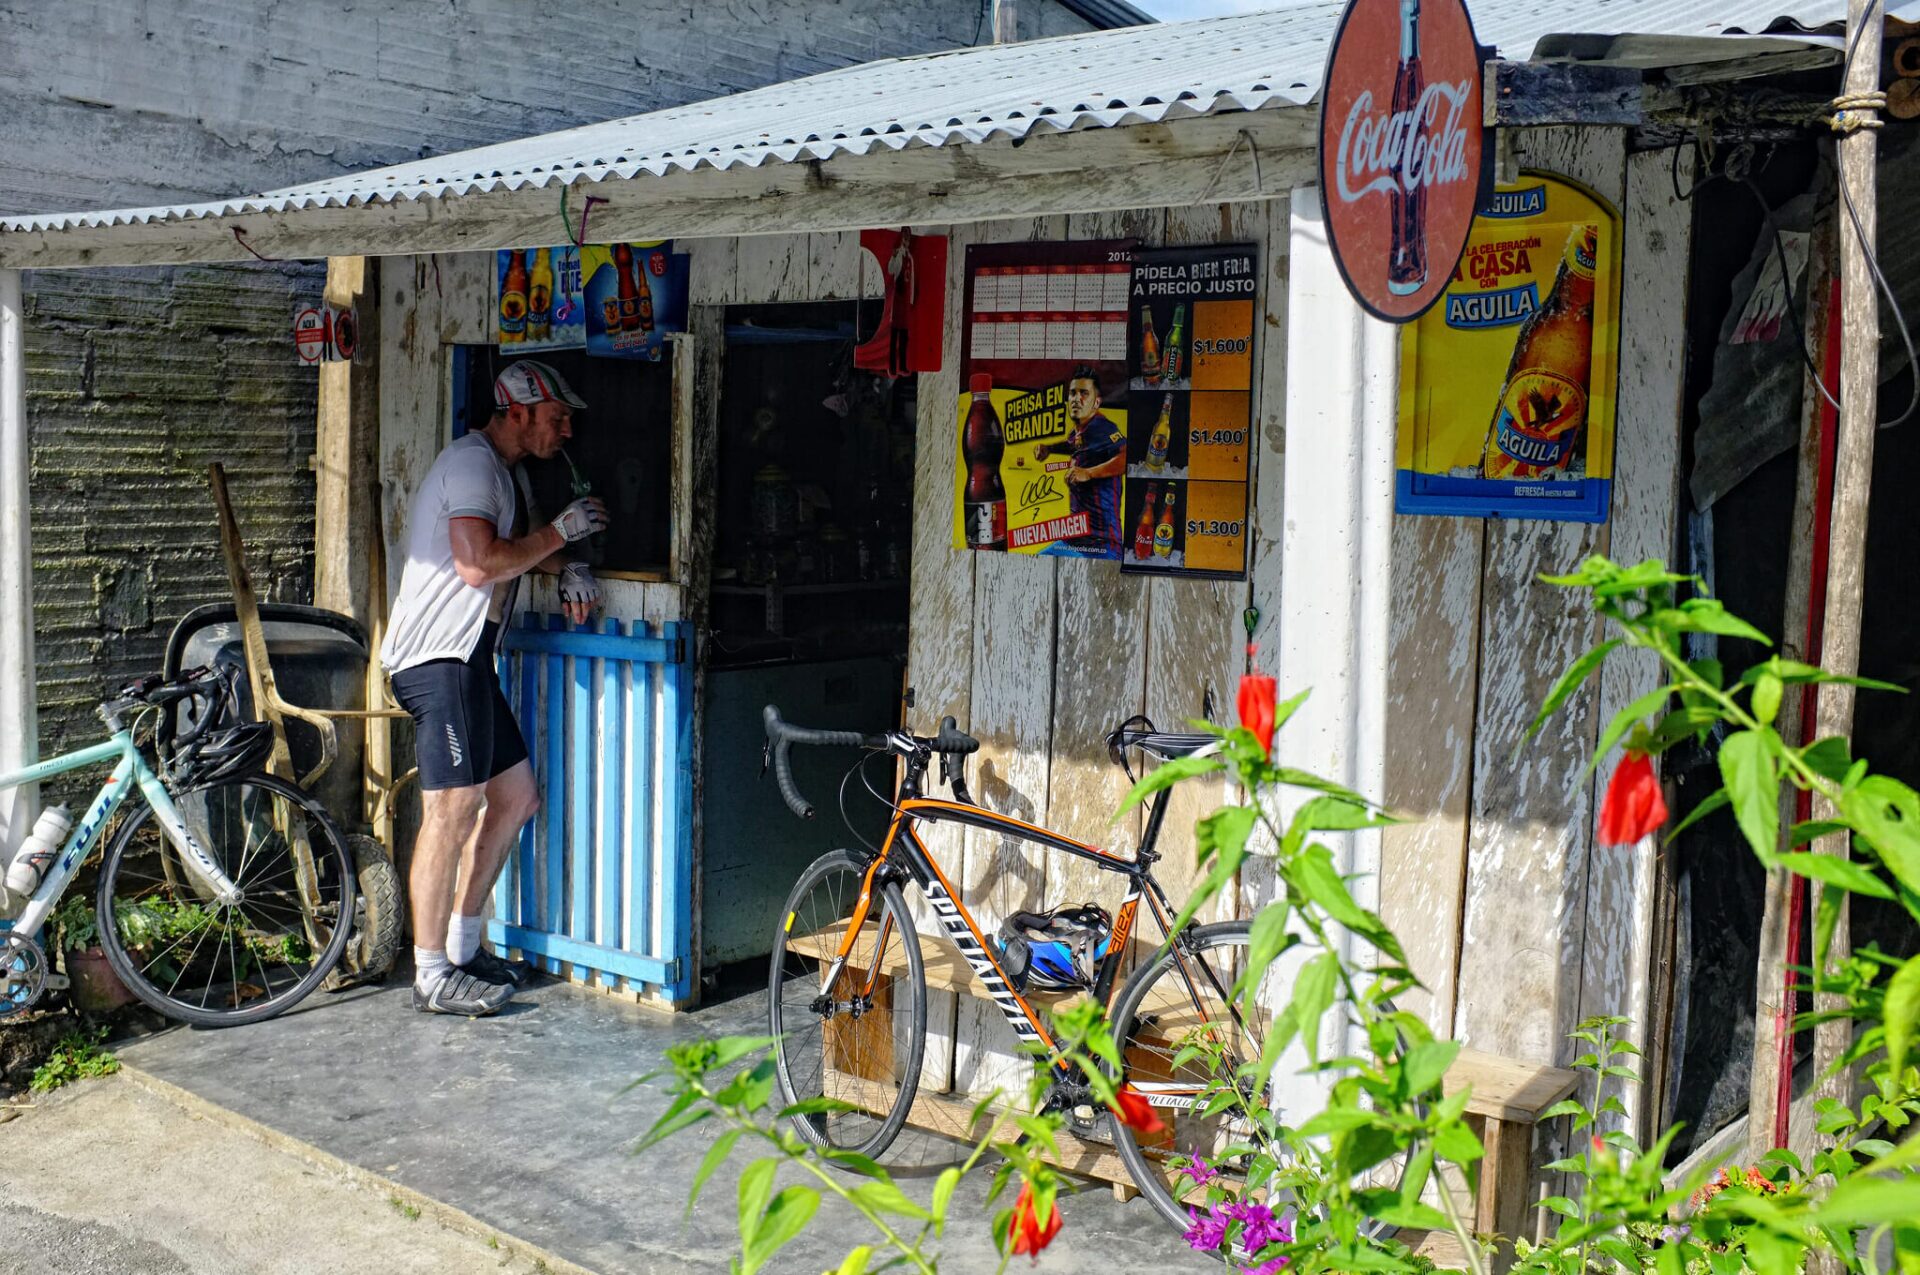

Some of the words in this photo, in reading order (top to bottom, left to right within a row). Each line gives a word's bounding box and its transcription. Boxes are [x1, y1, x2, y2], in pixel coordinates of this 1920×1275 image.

[1337, 77, 1472, 202] Coca-Cola
[1487, 193, 1540, 213] GUILA
[1108, 252, 1132, 263] 2012
[1466, 246, 1478, 257] LA
[1480, 236, 1541, 255] CELEBRACIÓN
[1135, 264, 1187, 281] PÍDELA
[1191, 261, 1220, 280] BIEN
[1469, 250, 1532, 280] CASA
[1133, 283, 1144, 296] A
[1149, 281, 1202, 296] PRECIO
[1205, 279, 1255, 294] JUSTO
[1480, 277, 1498, 288] CON
[1450, 290, 1533, 321] AGUILA
[1007, 389, 1043, 419] PIENSA
[1046, 383, 1065, 407] EN
[1005, 408, 1065, 442] GRANDE
[1499, 428, 1560, 462] AGUILA
[1514, 486, 1545, 497] REFRESCA
[977, 501, 993, 544] BIG
[1012, 523, 1048, 547] NUEVA
[1048, 514, 1088, 540] IMAGEN
[1188, 521, 1240, 536] $1.300
[63, 796, 113, 873] FUJI
[177, 824, 211, 866] FUJI
